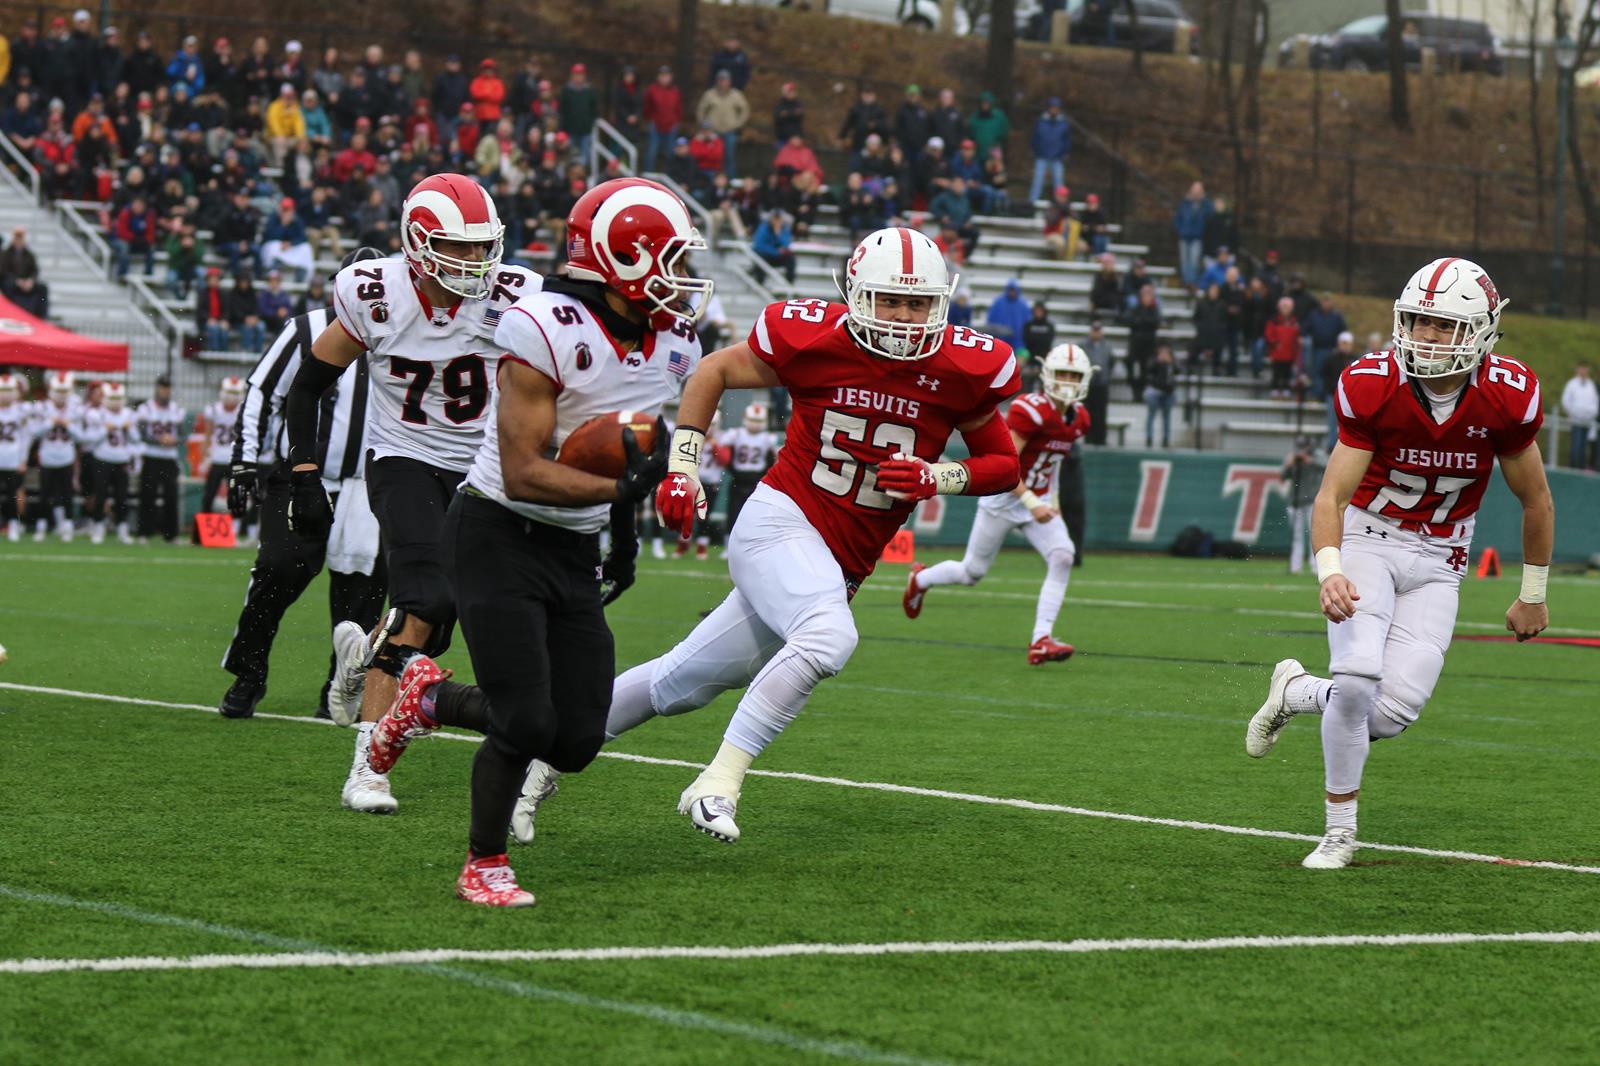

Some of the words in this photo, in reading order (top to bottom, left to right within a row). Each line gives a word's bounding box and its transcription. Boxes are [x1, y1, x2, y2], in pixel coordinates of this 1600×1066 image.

[354, 267, 386, 301] 79
[491, 271, 526, 305] 79
[899, 276, 919, 286] PREP
[552, 304, 584, 326] 5
[1418, 299, 1436, 309] PREP
[389, 352, 490, 426] 79
[832, 387, 920, 419] JESUITS
[810, 408, 917, 511] 52
[1394, 448, 1478, 470] JESUITS
[1366, 468, 1479, 525] 27
[205, 516, 230, 538] 50
